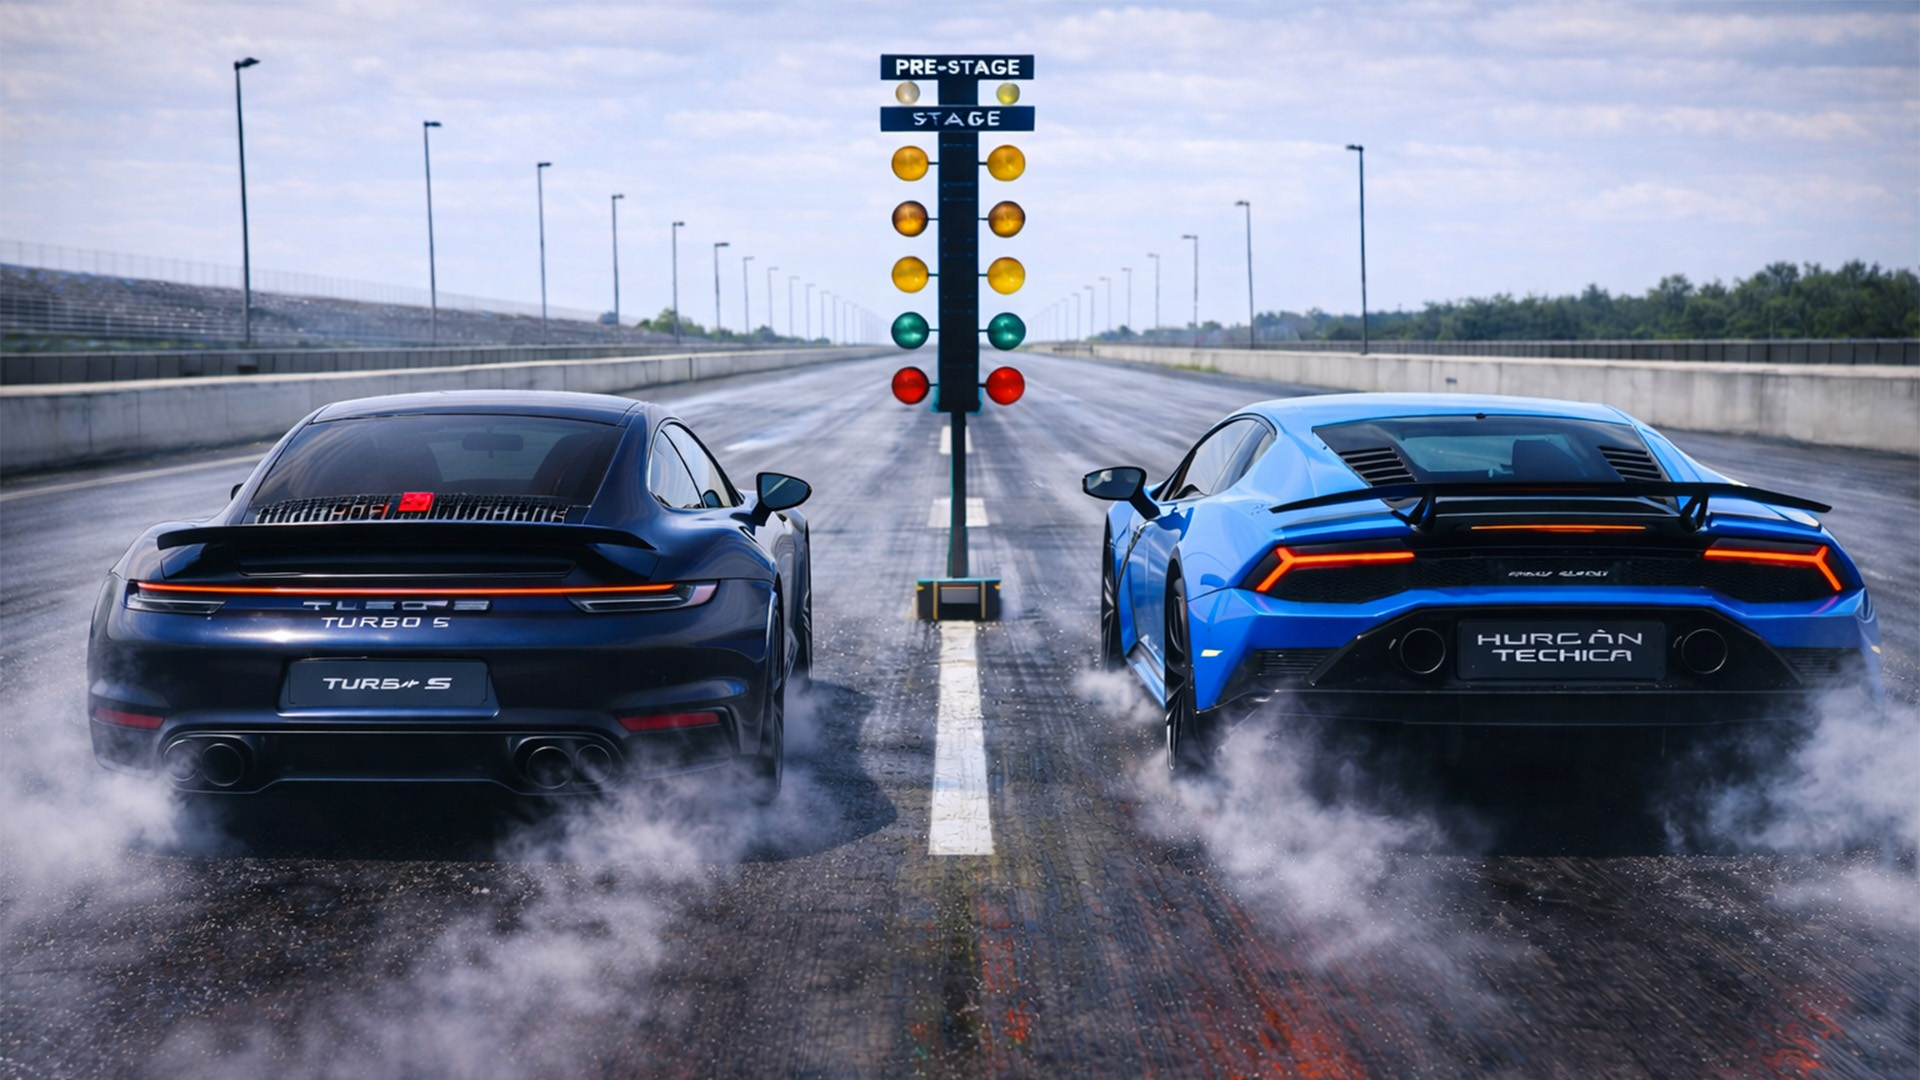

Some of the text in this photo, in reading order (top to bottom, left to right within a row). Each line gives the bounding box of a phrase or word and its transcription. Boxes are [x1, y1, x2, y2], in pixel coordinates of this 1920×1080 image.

[895, 58, 1020, 76] PRE-STAGE
[913, 111, 1001, 126] STAGE
[321, 617, 421, 628] TURBO
[1492, 649, 1632, 662] TECHICA
[424, 678, 452, 690] S
